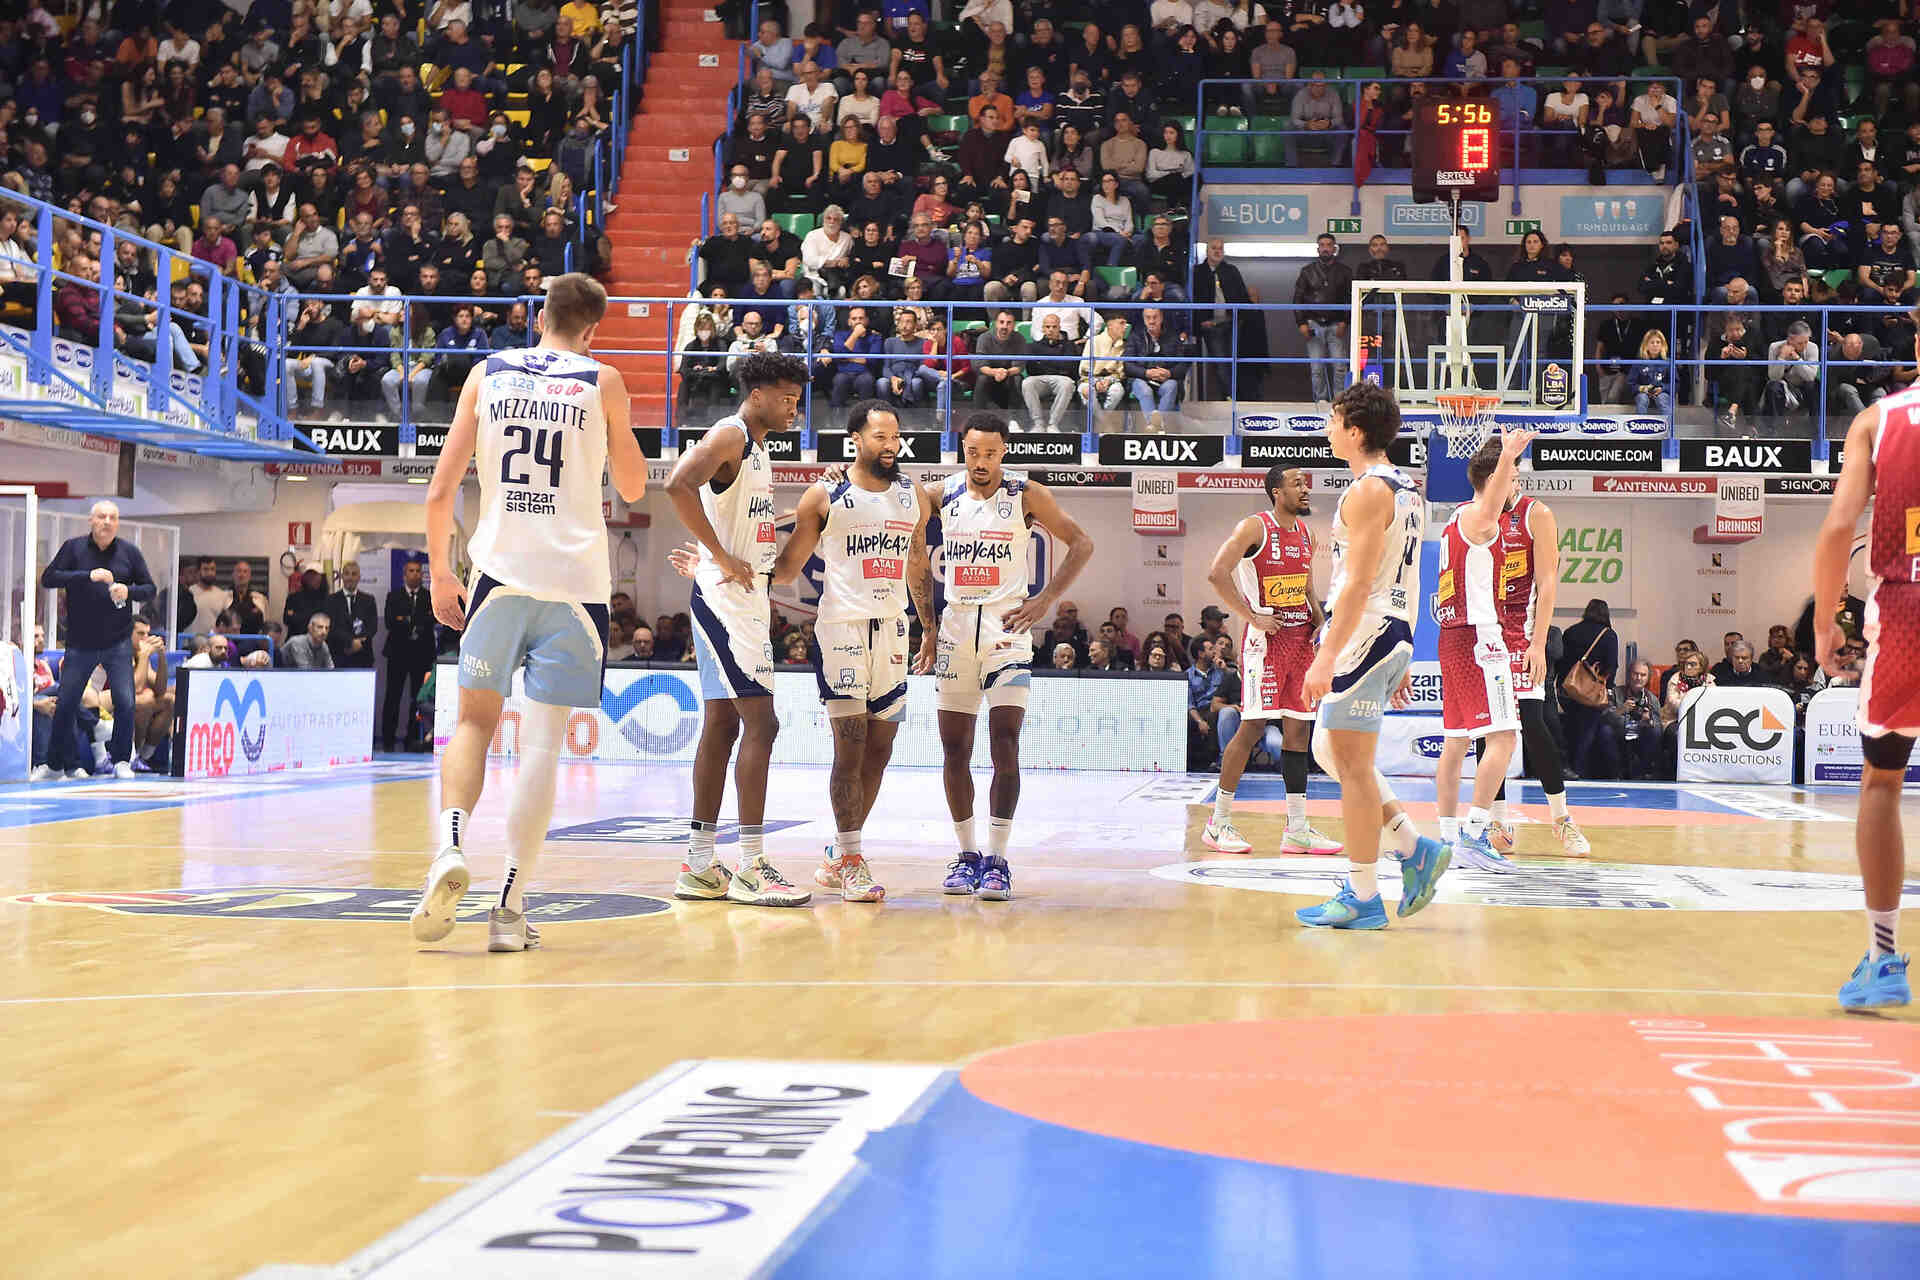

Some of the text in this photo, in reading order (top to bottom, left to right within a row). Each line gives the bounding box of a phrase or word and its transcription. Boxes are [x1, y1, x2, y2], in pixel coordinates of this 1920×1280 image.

[1437, 104, 1491, 124] 5:56
[1462, 129, 1488, 168] 8
[1222, 206, 1237, 217] AL
[1524, 297, 1568, 311] UnipolSai
[490, 398, 588, 431] MEZZANOTTE
[311, 429, 382, 451] BAUX
[501, 425, 564, 487] 24
[1124, 439, 1198, 461] BAUX
[1250, 446, 1332, 459] BAUXCUCINE.
[1540, 449, 1653, 462] BAUXCUCINE.COM
[1705, 446, 1783, 468] BAUX
[347, 464, 372, 475] SUD
[1137, 479, 1174, 496] UNIBED
[1616, 480, 1706, 493] ANTENNA SUD
[1720, 485, 1759, 501] UNIBED
[1780, 480, 1830, 492] SIGNOR
[506, 490, 556, 503] zanzar
[844, 493, 855, 508] 6
[505, 501, 556, 515] sistem
[950, 501, 960, 516] 2
[1135, 513, 1176, 526] BRINDISI
[1717, 519, 1761, 533] BRINDISI
[1557, 527, 1624, 553] ACIA
[946, 540, 1012, 563] HAPPYCASA
[1271, 542, 1281, 560] 5
[962, 567, 992, 576] ATTAL
[1557, 558, 1624, 584] ZZO
[1683, 752, 1782, 766] CONSTRUCTIONS
[479, 1083, 871, 1254] POWERING
